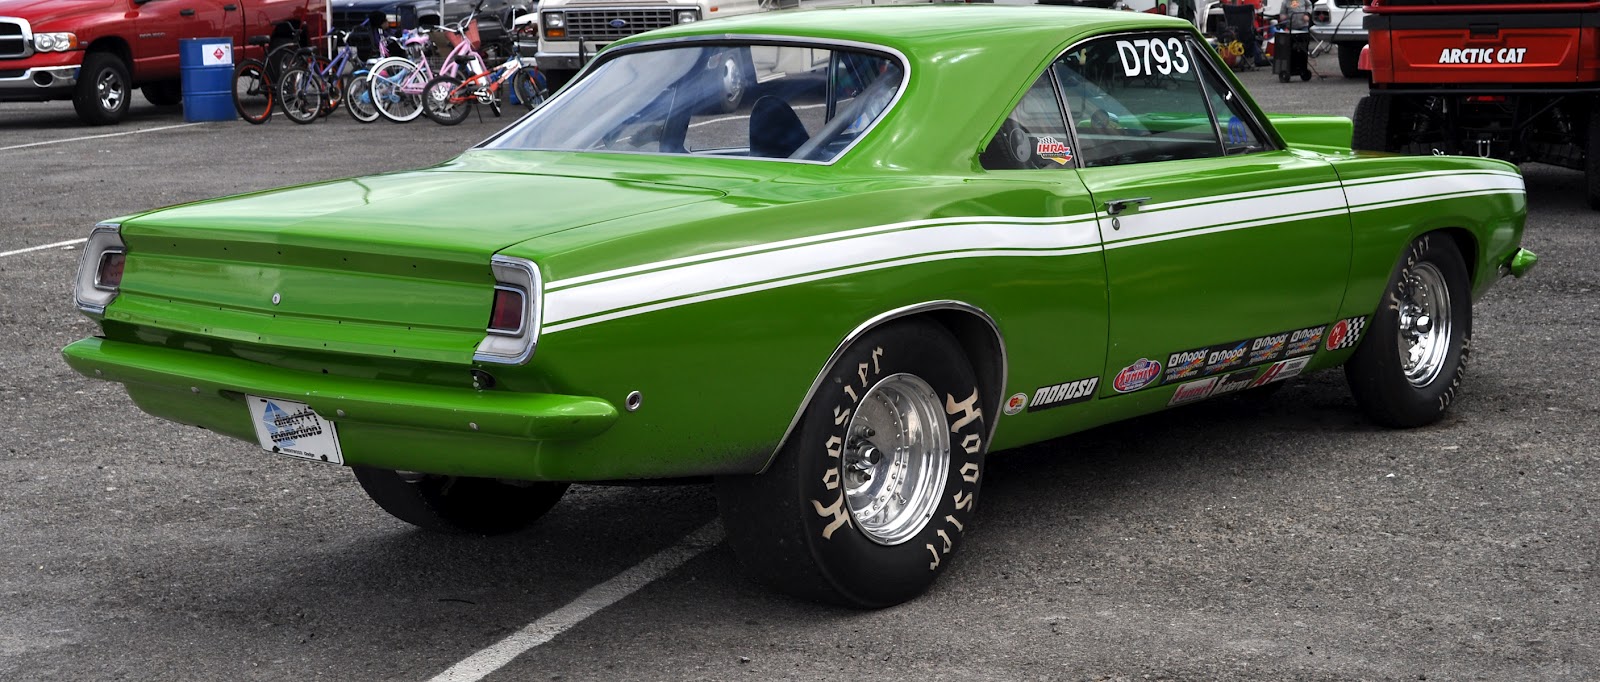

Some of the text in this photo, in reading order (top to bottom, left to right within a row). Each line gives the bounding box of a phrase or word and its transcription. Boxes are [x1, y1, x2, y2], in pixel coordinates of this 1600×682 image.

[1116, 37, 1189, 77] D793
[1439, 48, 1526, 63] ARCTIC CAT
[1038, 144, 1066, 153] IHRA
[1178, 349, 1209, 364] Mopar
[1029, 377, 1099, 408] MOROSO
[811, 346, 884, 540] Hoosier
[925, 386, 984, 571] Hoosier
